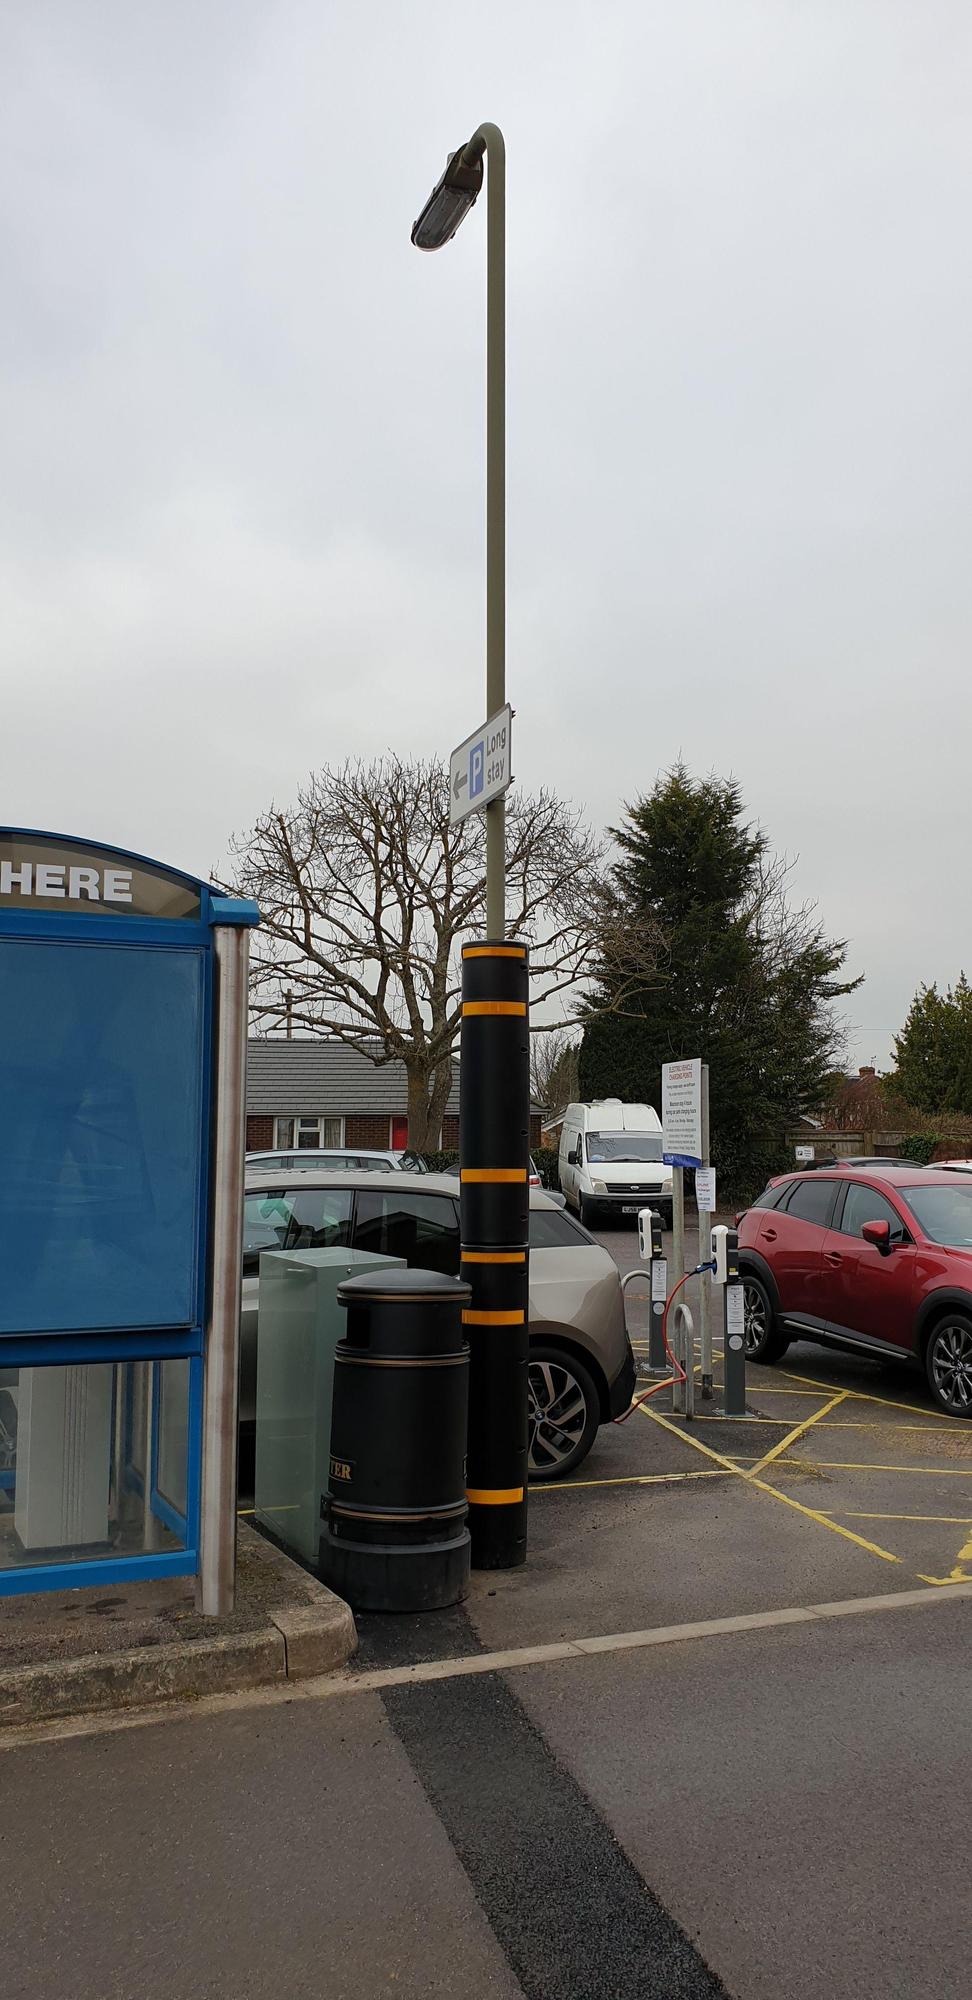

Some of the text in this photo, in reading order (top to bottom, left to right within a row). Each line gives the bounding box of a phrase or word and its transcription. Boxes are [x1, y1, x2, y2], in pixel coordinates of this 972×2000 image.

[486, 727, 507, 757] Long
[473, 750, 482, 793] P
[487, 757, 505, 785] stay
[0, 861, 132, 902] HERE
